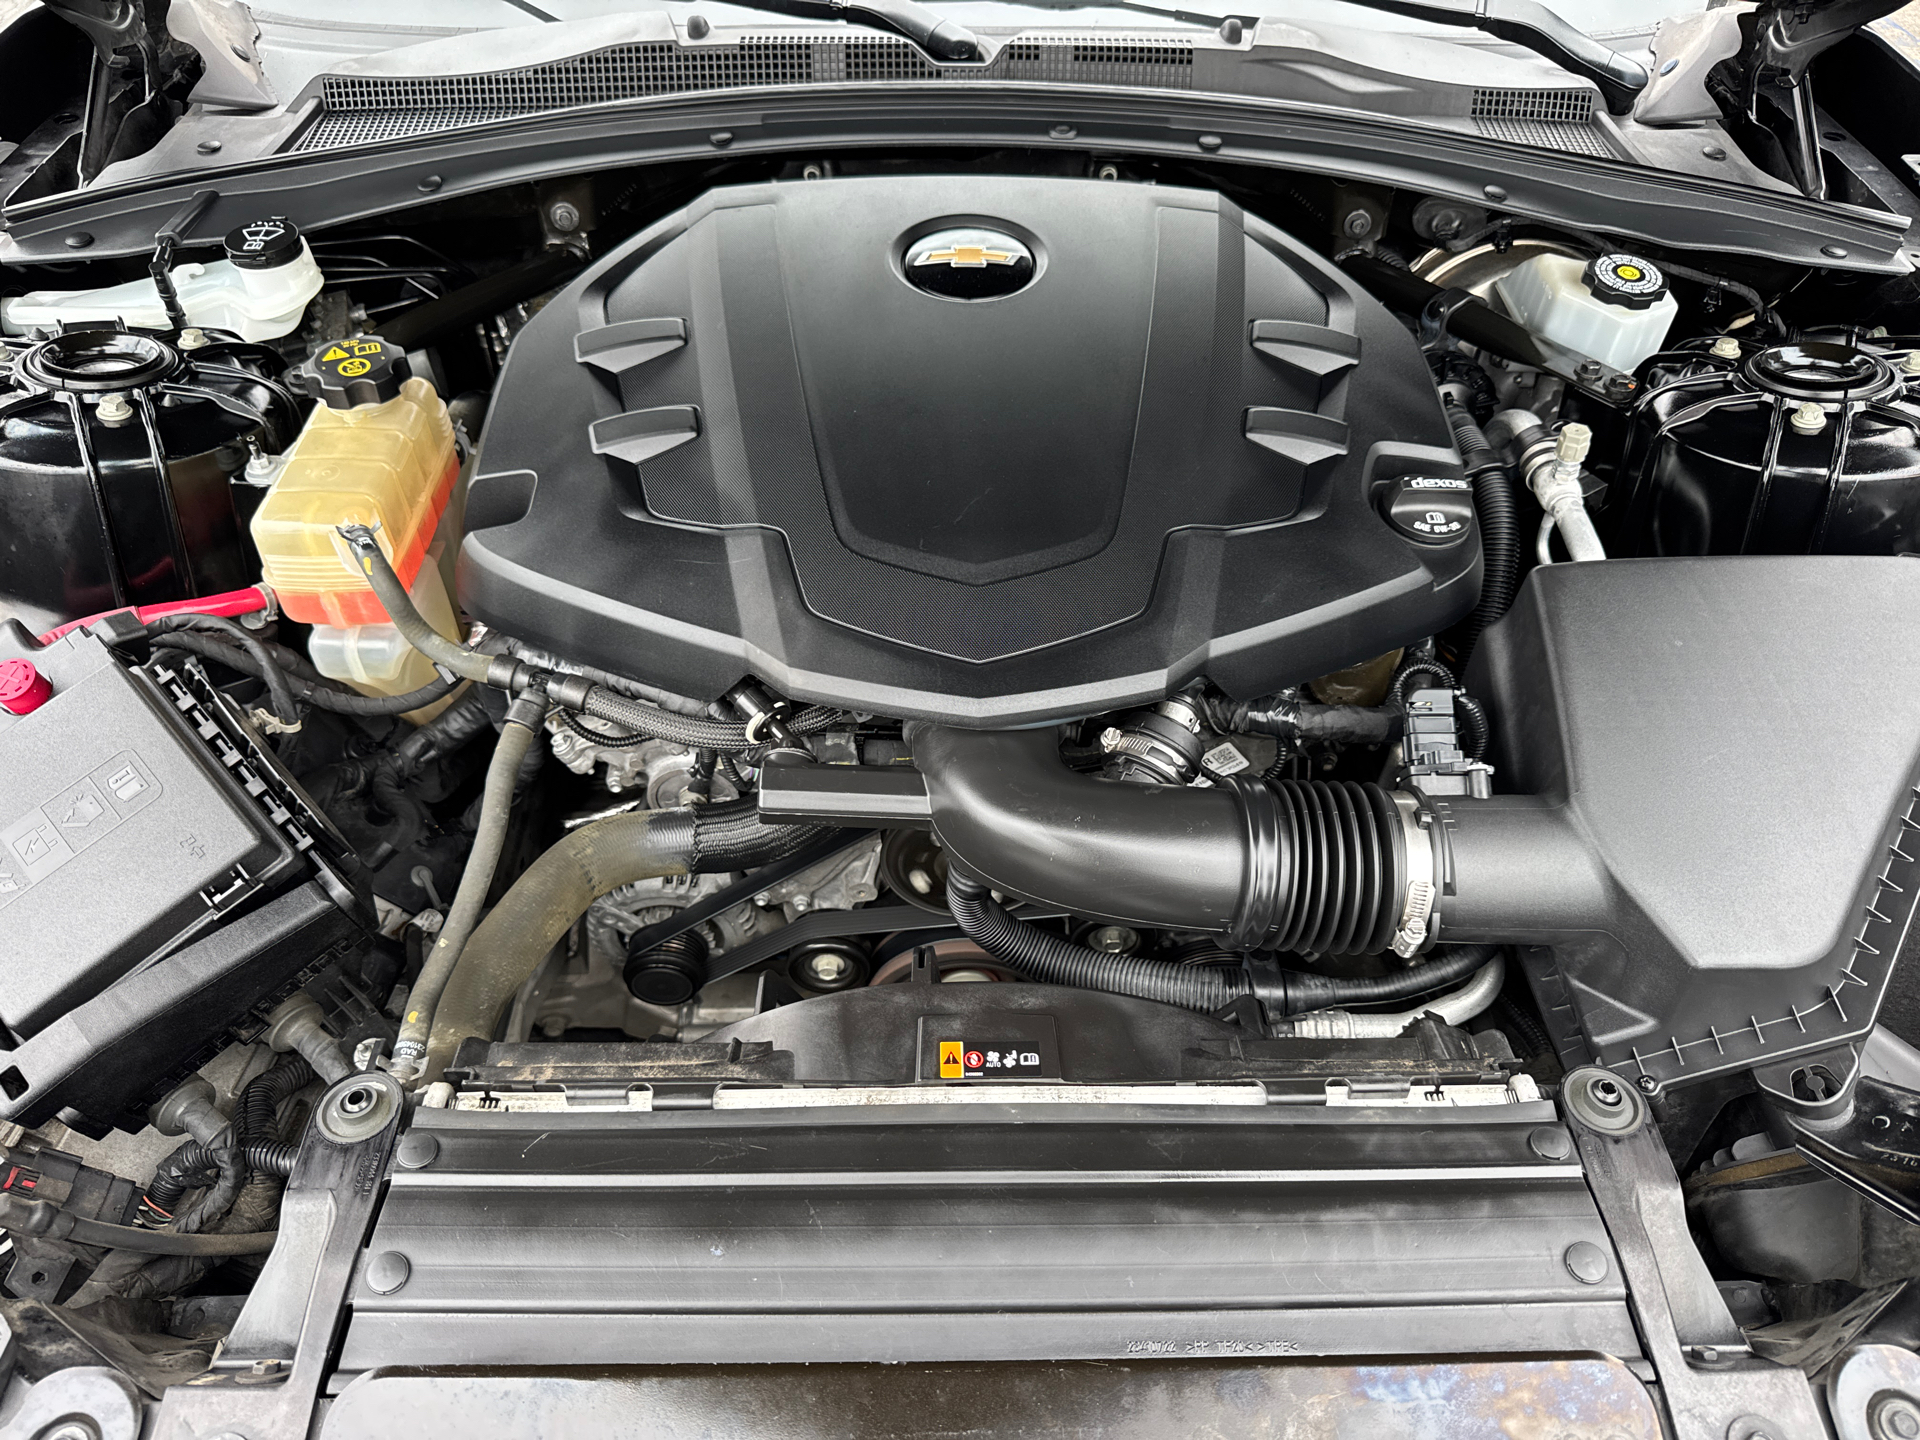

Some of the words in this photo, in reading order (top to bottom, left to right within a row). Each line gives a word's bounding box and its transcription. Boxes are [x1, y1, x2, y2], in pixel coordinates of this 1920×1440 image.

[1410, 476, 1468, 489] dexos
[1413, 521, 1431, 532] SAE
[400, 1047, 418, 1056] RAD
